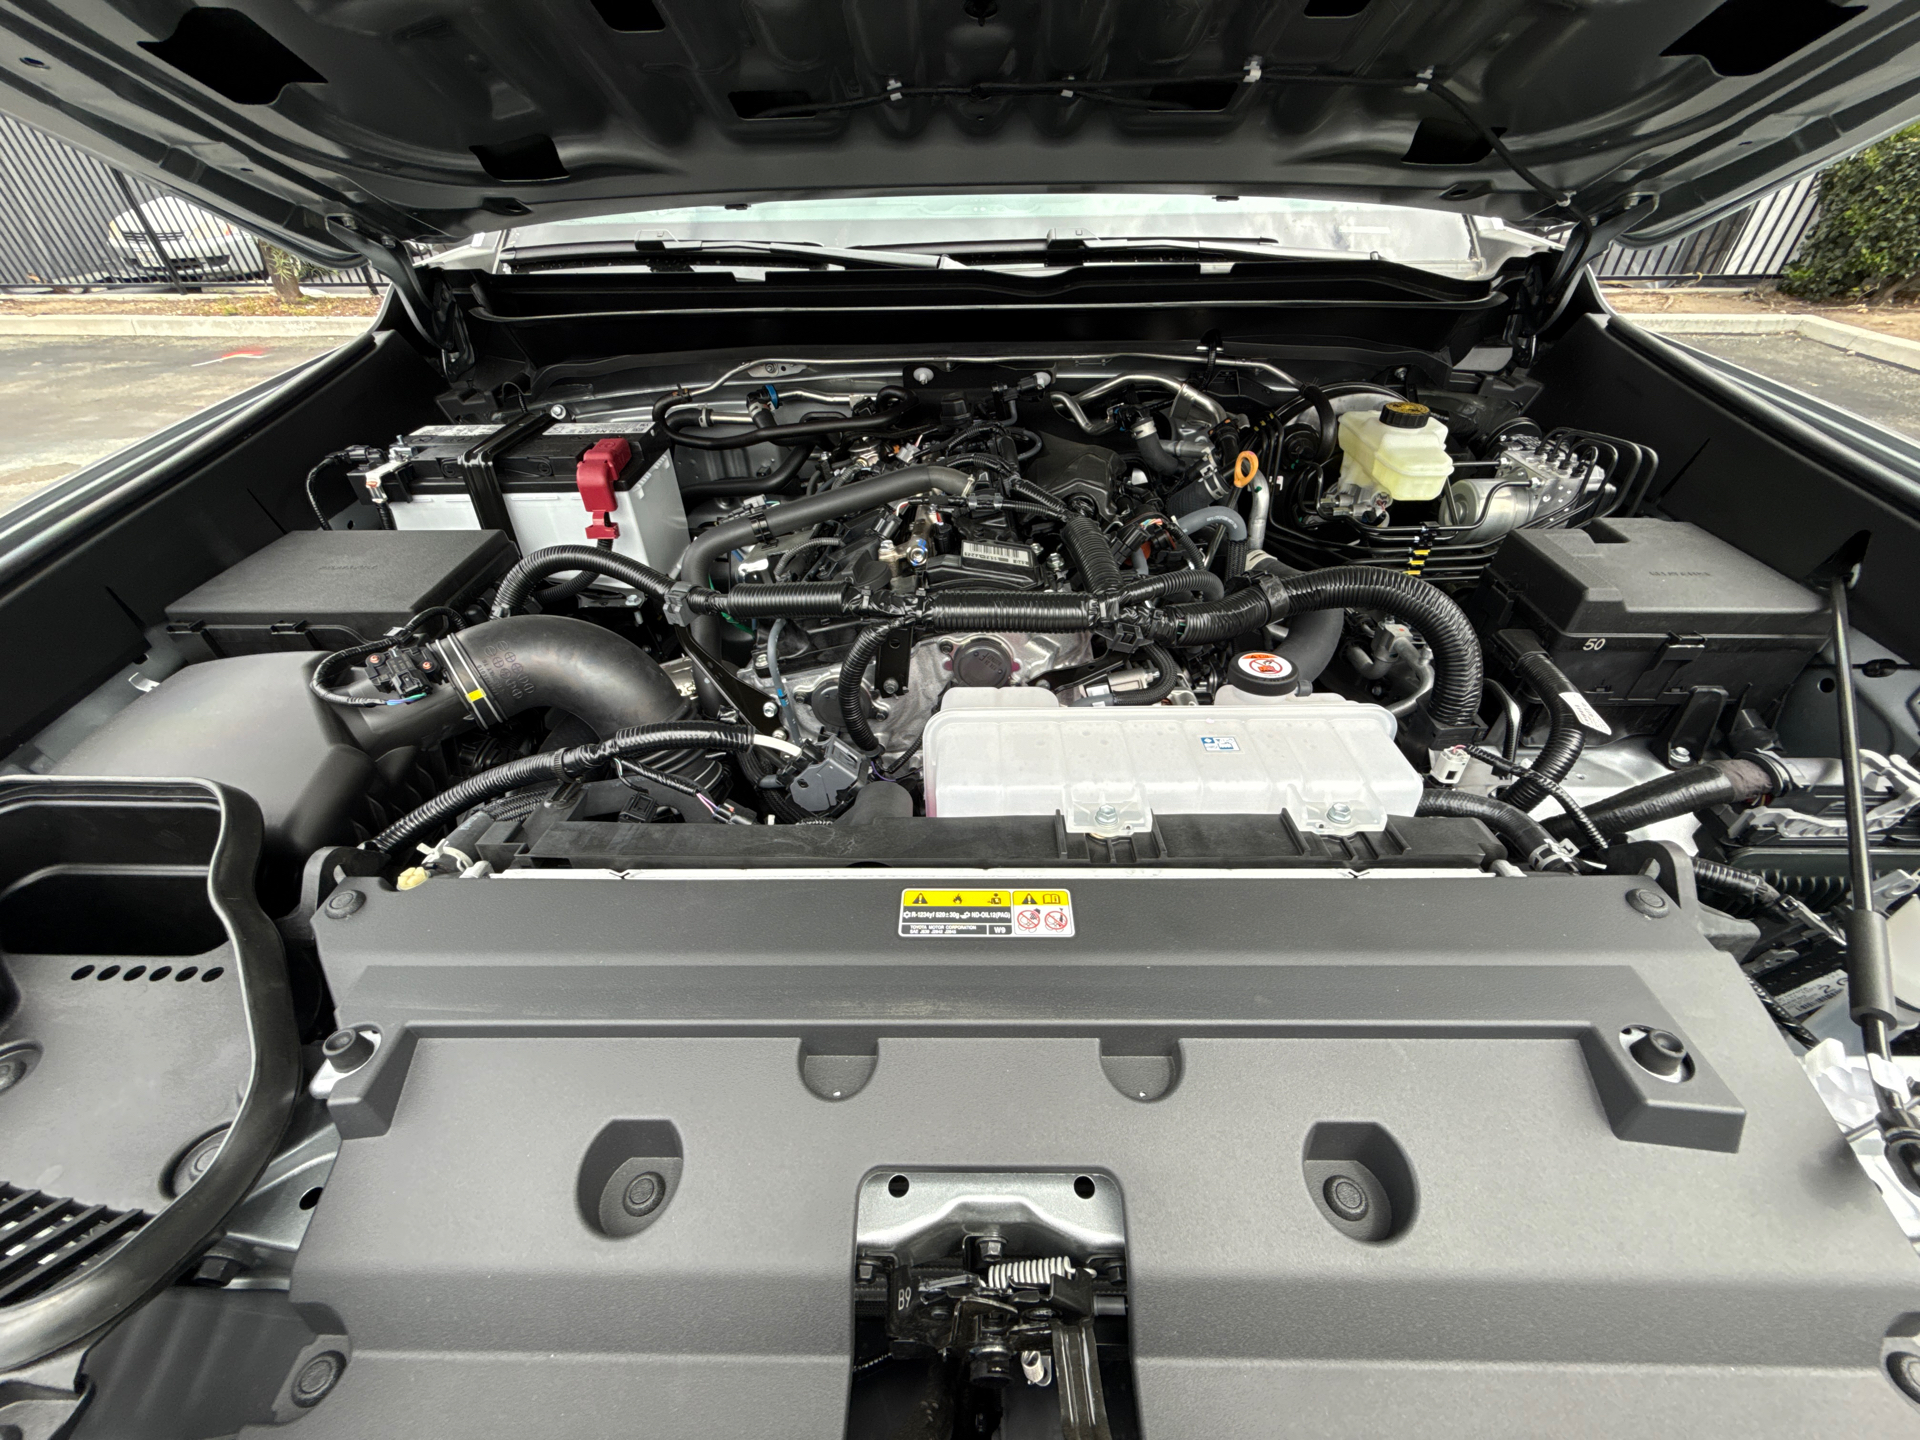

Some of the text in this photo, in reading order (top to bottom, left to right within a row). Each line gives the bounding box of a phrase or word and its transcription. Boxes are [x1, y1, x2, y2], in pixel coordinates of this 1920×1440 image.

[1582, 638, 1606, 651] 50
[994, 926, 1007, 934] W9
[898, 1286, 911, 1311] B9
